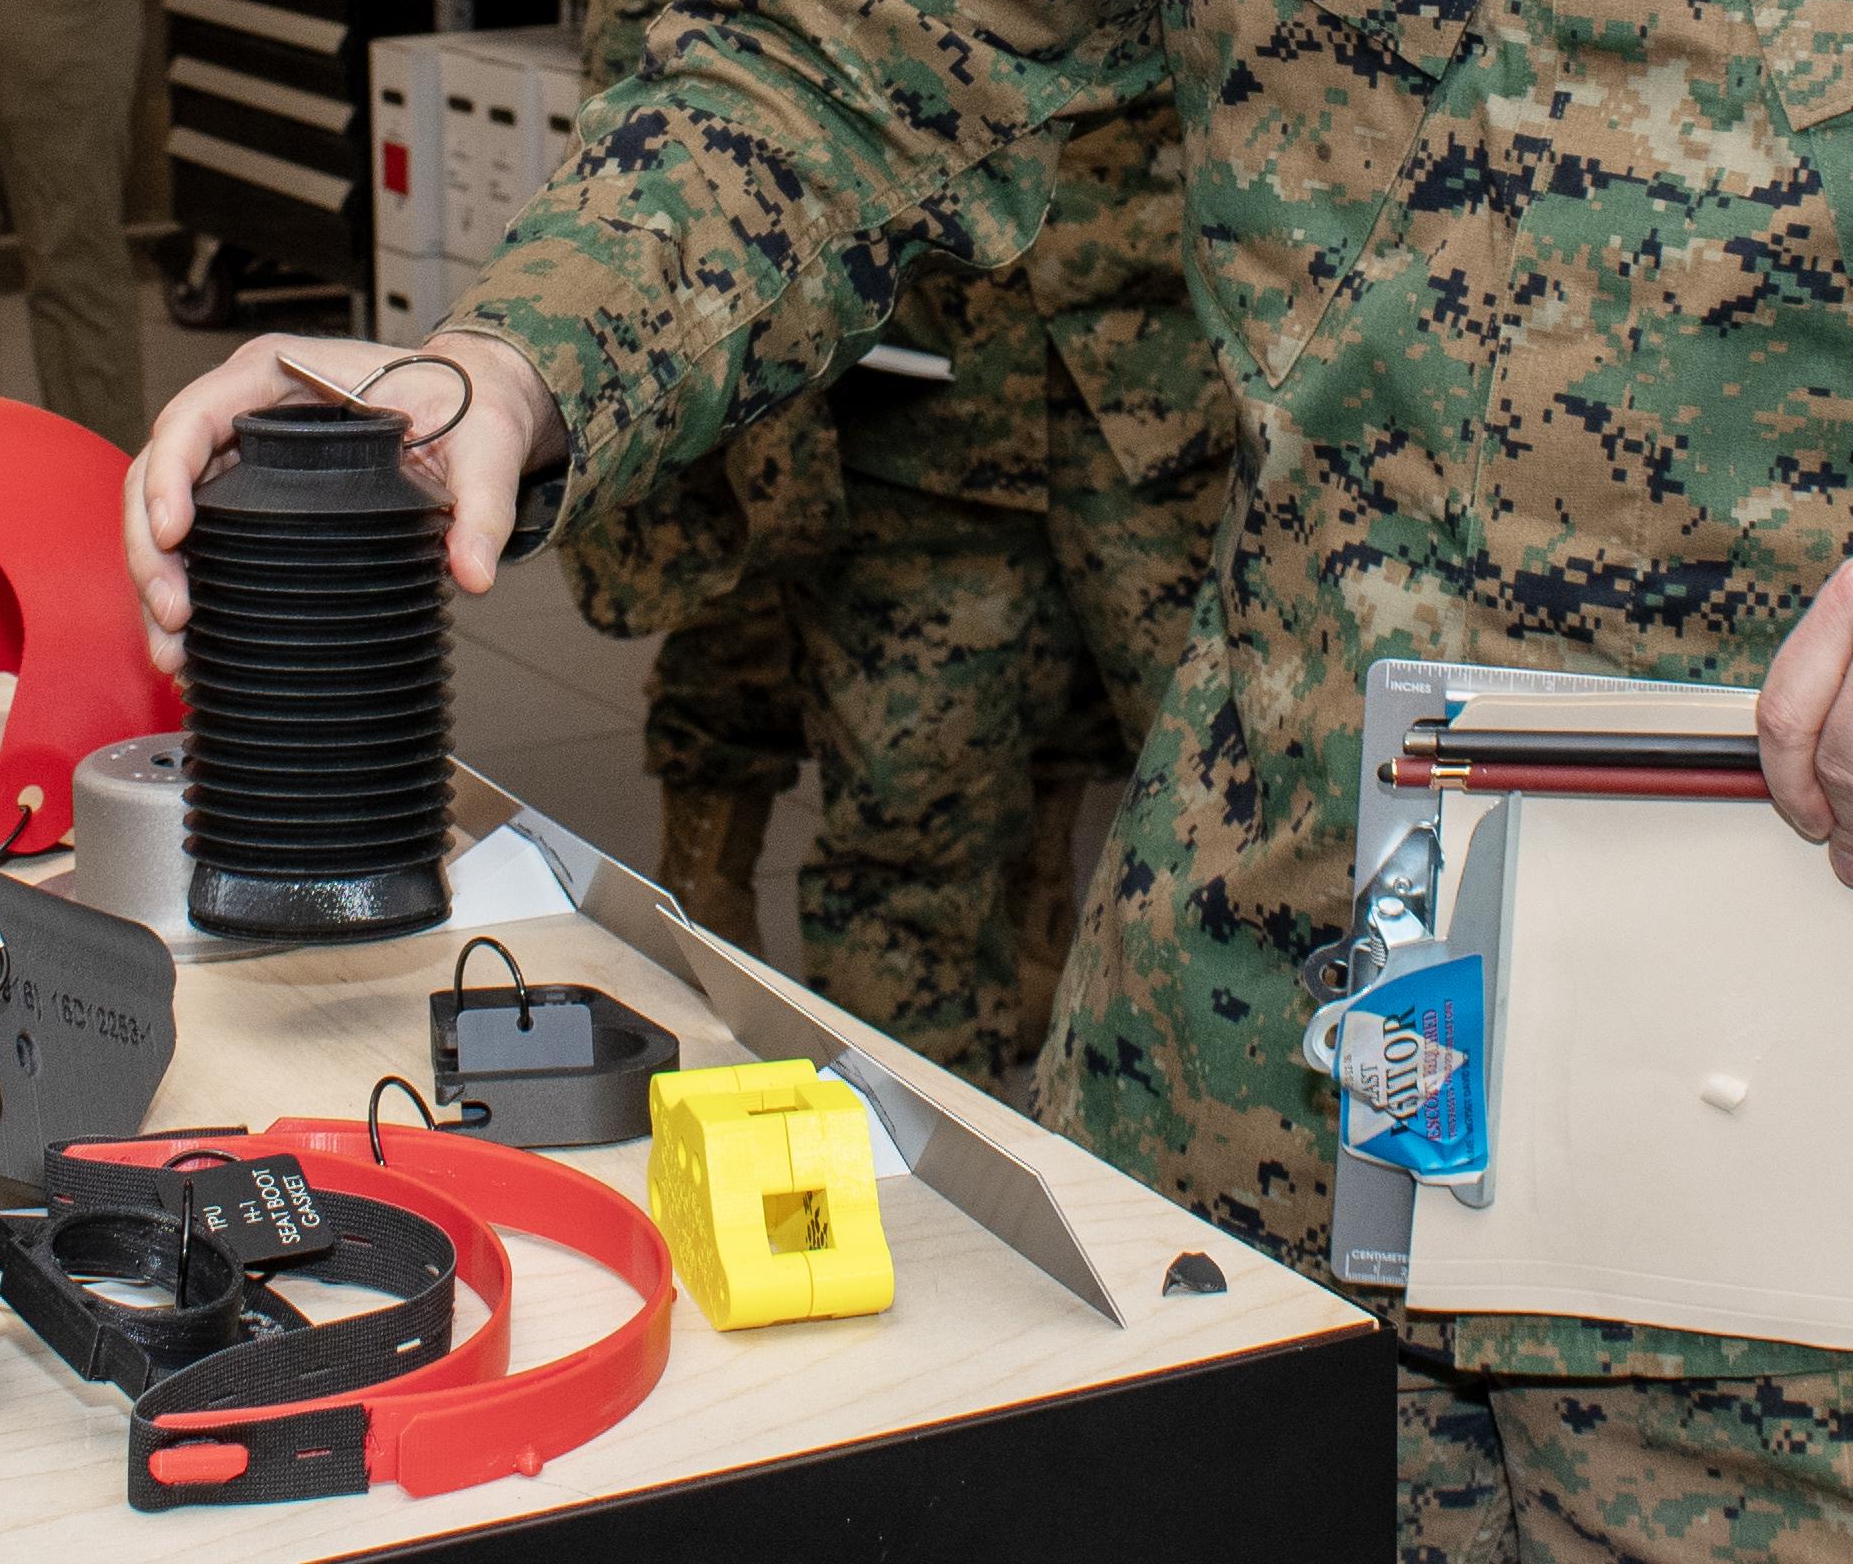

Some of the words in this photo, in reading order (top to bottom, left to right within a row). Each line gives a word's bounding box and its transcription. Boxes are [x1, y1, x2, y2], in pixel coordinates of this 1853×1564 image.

[1390, 681, 1432, 694] INCHES
[252, 1168, 285, 1211] BOOT
[282, 1174, 321, 1229] GASKET
[202, 1205, 228, 1233] TPU
[270, 1209, 301, 1245] SEAT
